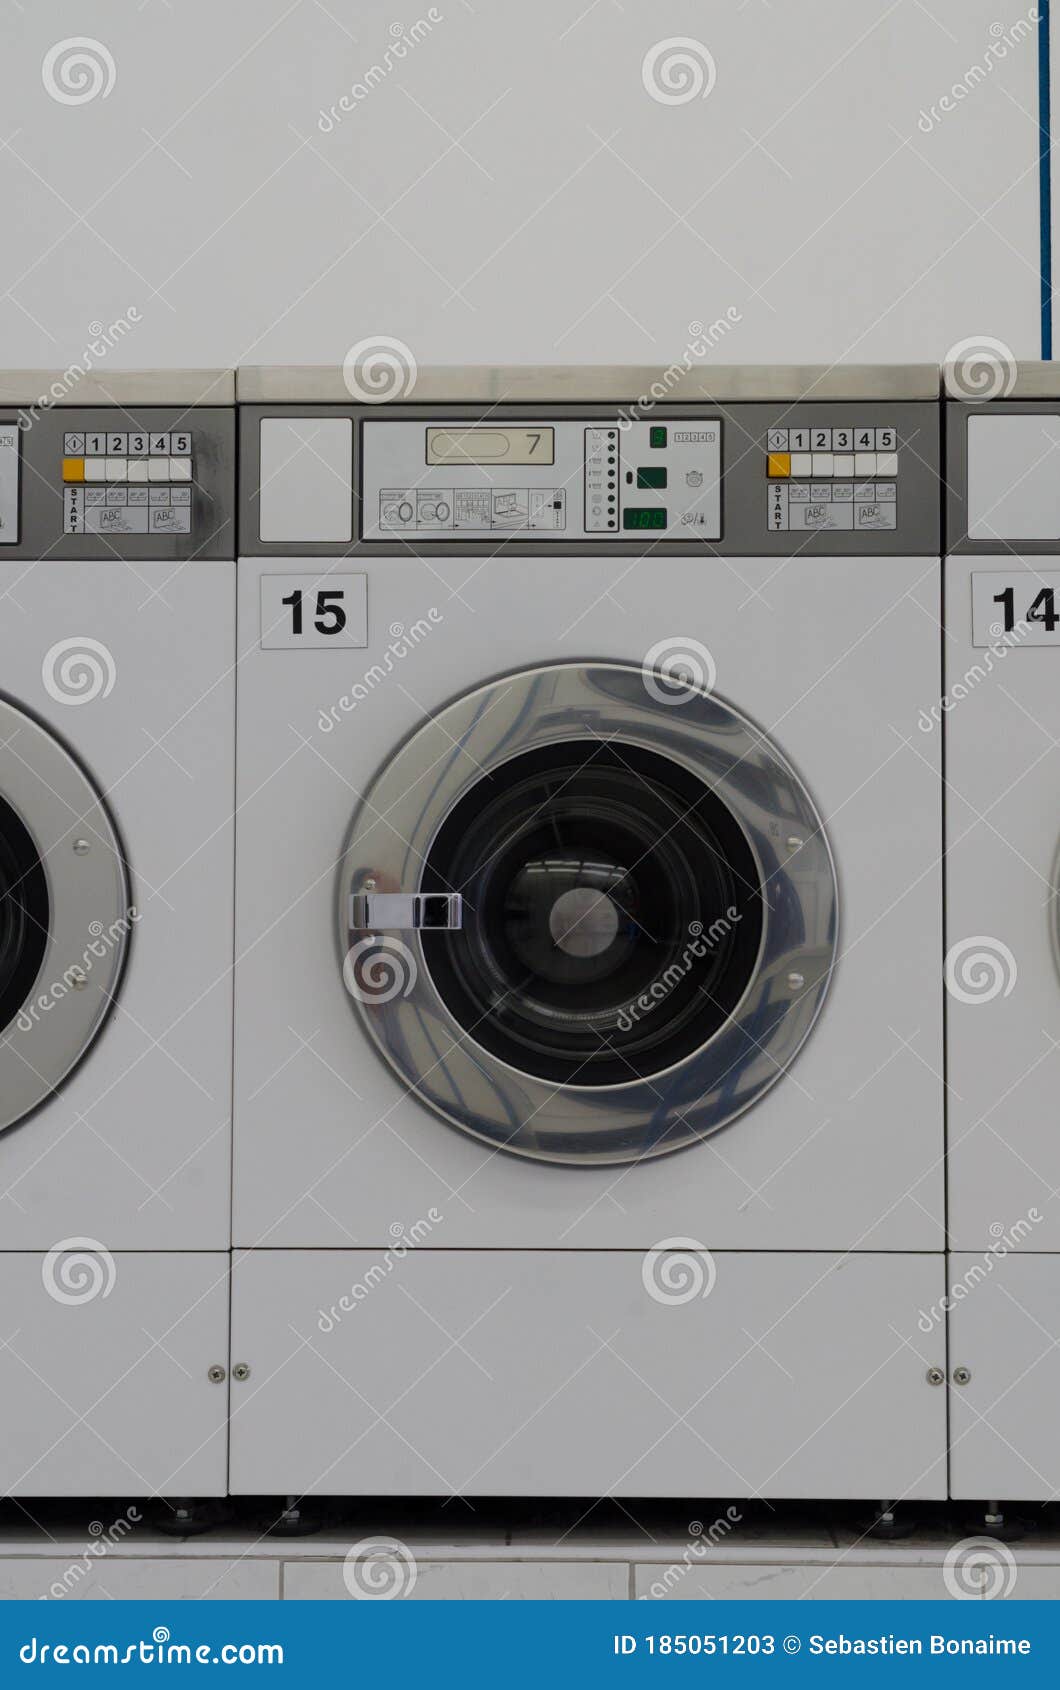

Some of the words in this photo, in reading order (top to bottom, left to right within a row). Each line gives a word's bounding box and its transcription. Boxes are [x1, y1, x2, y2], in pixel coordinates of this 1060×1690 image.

[91, 438, 98, 450] 1
[113, 438, 122, 451] 2
[134, 438, 143, 451] 3
[155, 438, 165, 451] 4
[177, 438, 187, 451] 5
[526, 434, 541, 455] 7
[795, 434, 802, 447] 1
[816, 433, 826, 447] 2
[838, 433, 848, 447] 3
[860, 433, 870, 446] 4
[882, 433, 891, 446] 5
[70, 488, 78, 533] START
[774, 485, 782, 530] START
[807, 505, 825, 519] ABC
[861, 505, 879, 519] ABC
[102, 510, 120, 522] ABC
[156, 510, 173, 522] ABC
[281, 589, 347, 635] 15
[993, 587, 1060, 632] 14
